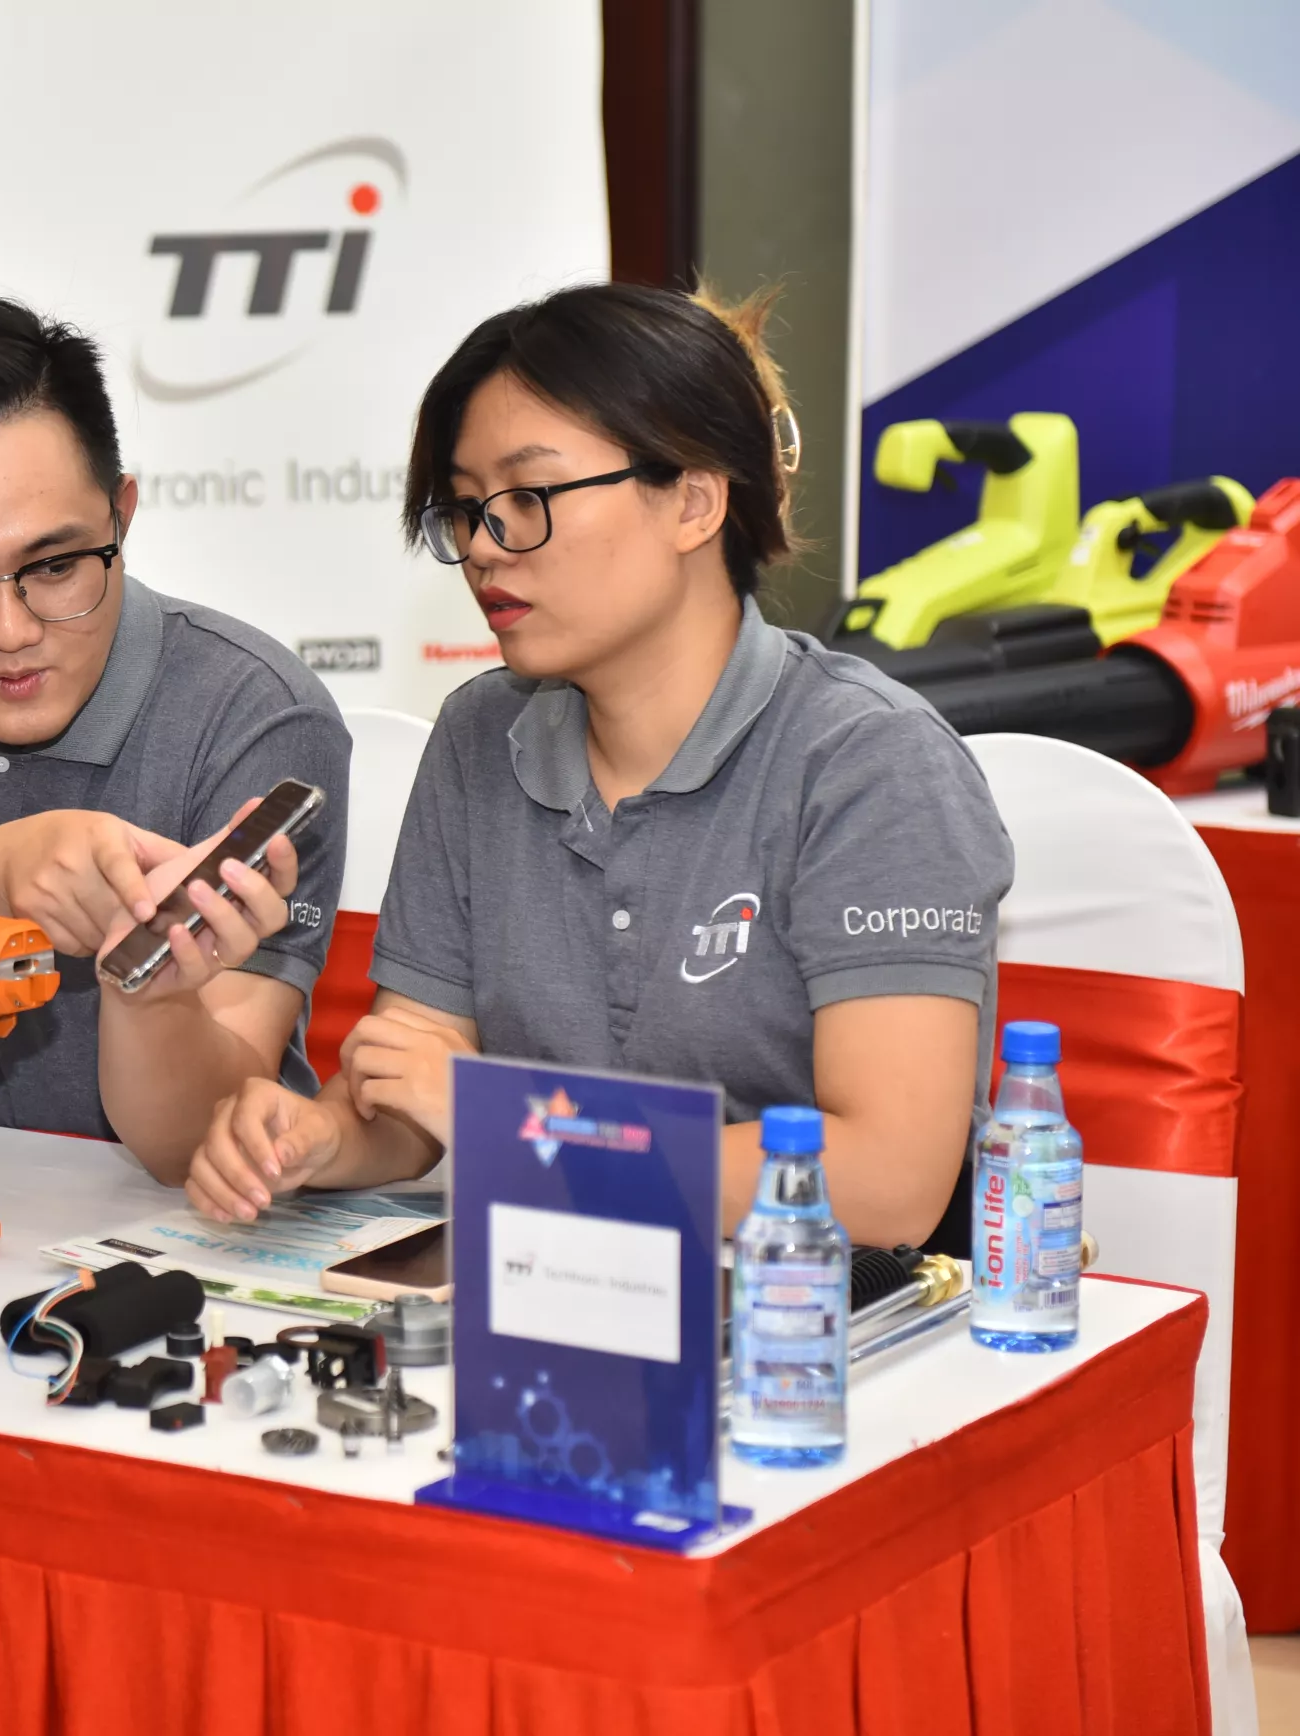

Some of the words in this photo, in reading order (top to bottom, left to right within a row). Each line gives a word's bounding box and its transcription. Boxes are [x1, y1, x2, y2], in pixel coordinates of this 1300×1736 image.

[136, 462, 266, 509] tronic
[285, 458, 407, 504] Indus
[284, 899, 321, 928] rate
[843, 904, 982, 938] Corporate
[984, 1174, 1006, 1229] Life
[979, 1237, 1005, 1289] i-on
